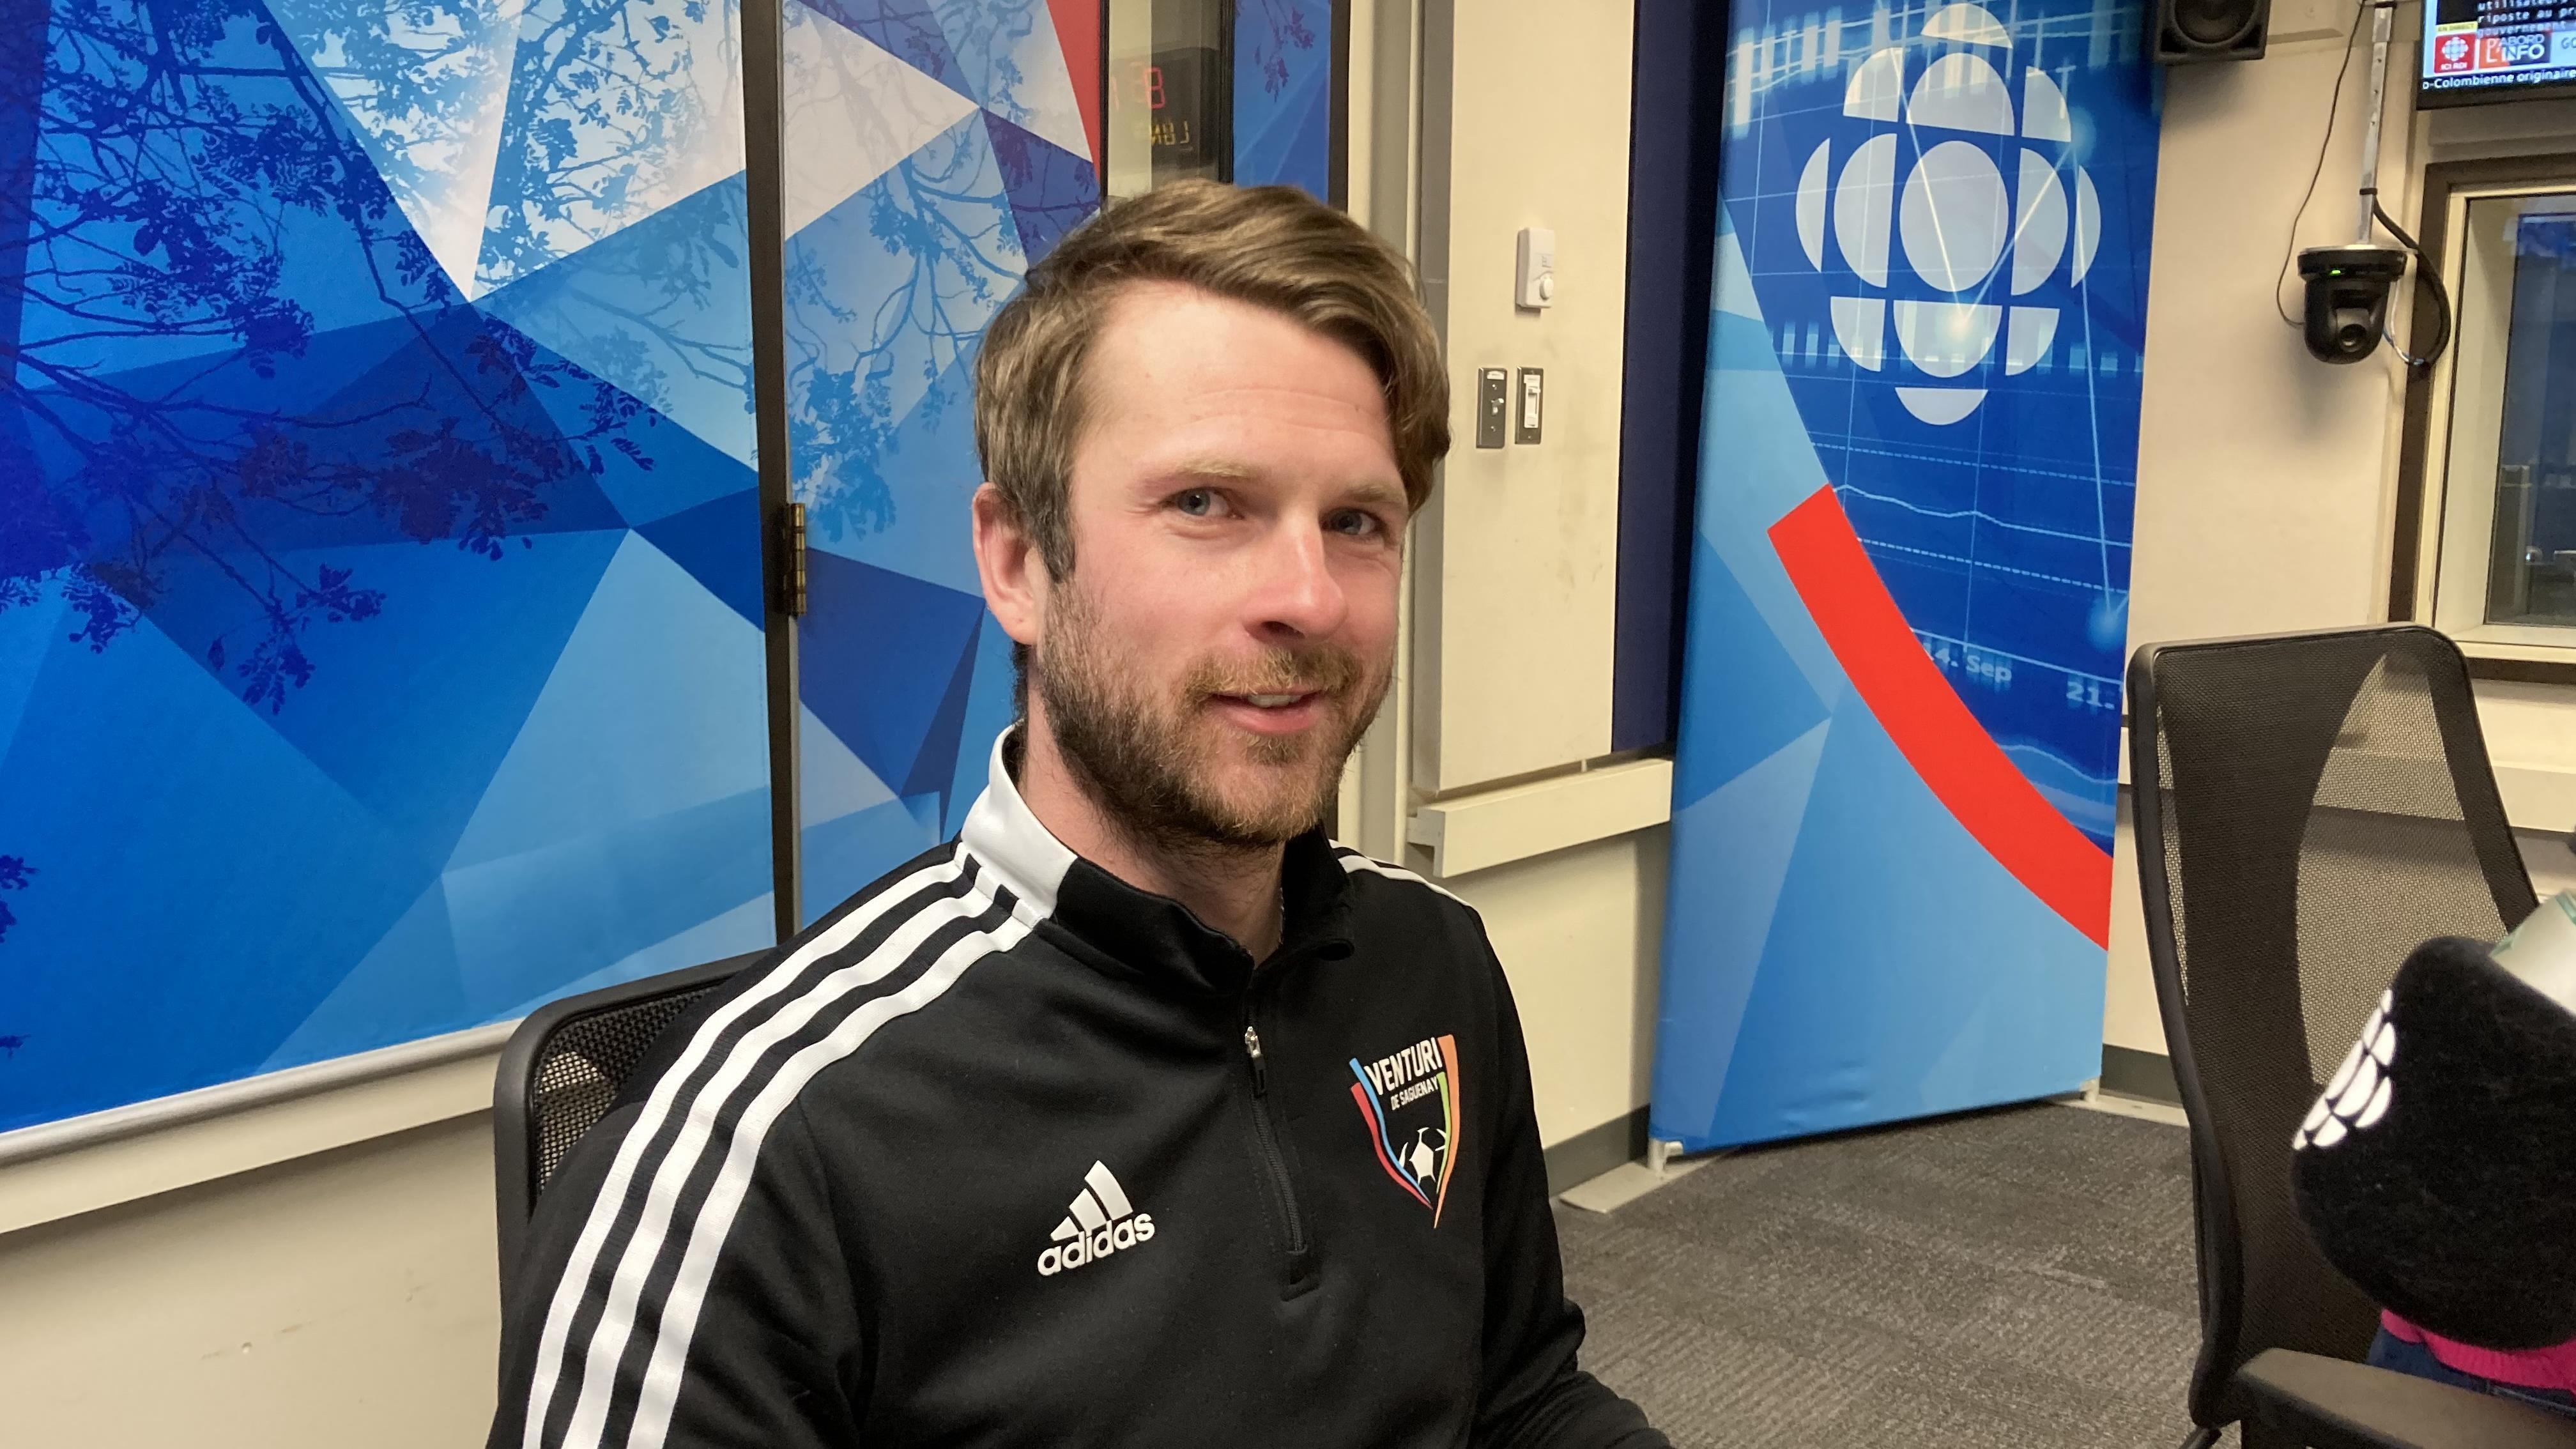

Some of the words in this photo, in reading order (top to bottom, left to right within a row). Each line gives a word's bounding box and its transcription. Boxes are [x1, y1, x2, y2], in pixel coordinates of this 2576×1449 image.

[2478, 11, 2529, 25] riposte
[2538, 10, 2552, 19] au
[1966, 655, 2012, 683] Sep
[2066, 680, 2115, 710] 21.
[1363, 1036, 1443, 1096] VENTURI
[1390, 1094, 1400, 1111] DE
[1399, 1076, 1439, 1106] SAGUENAY
[1037, 1213, 1156, 1276] adidas
